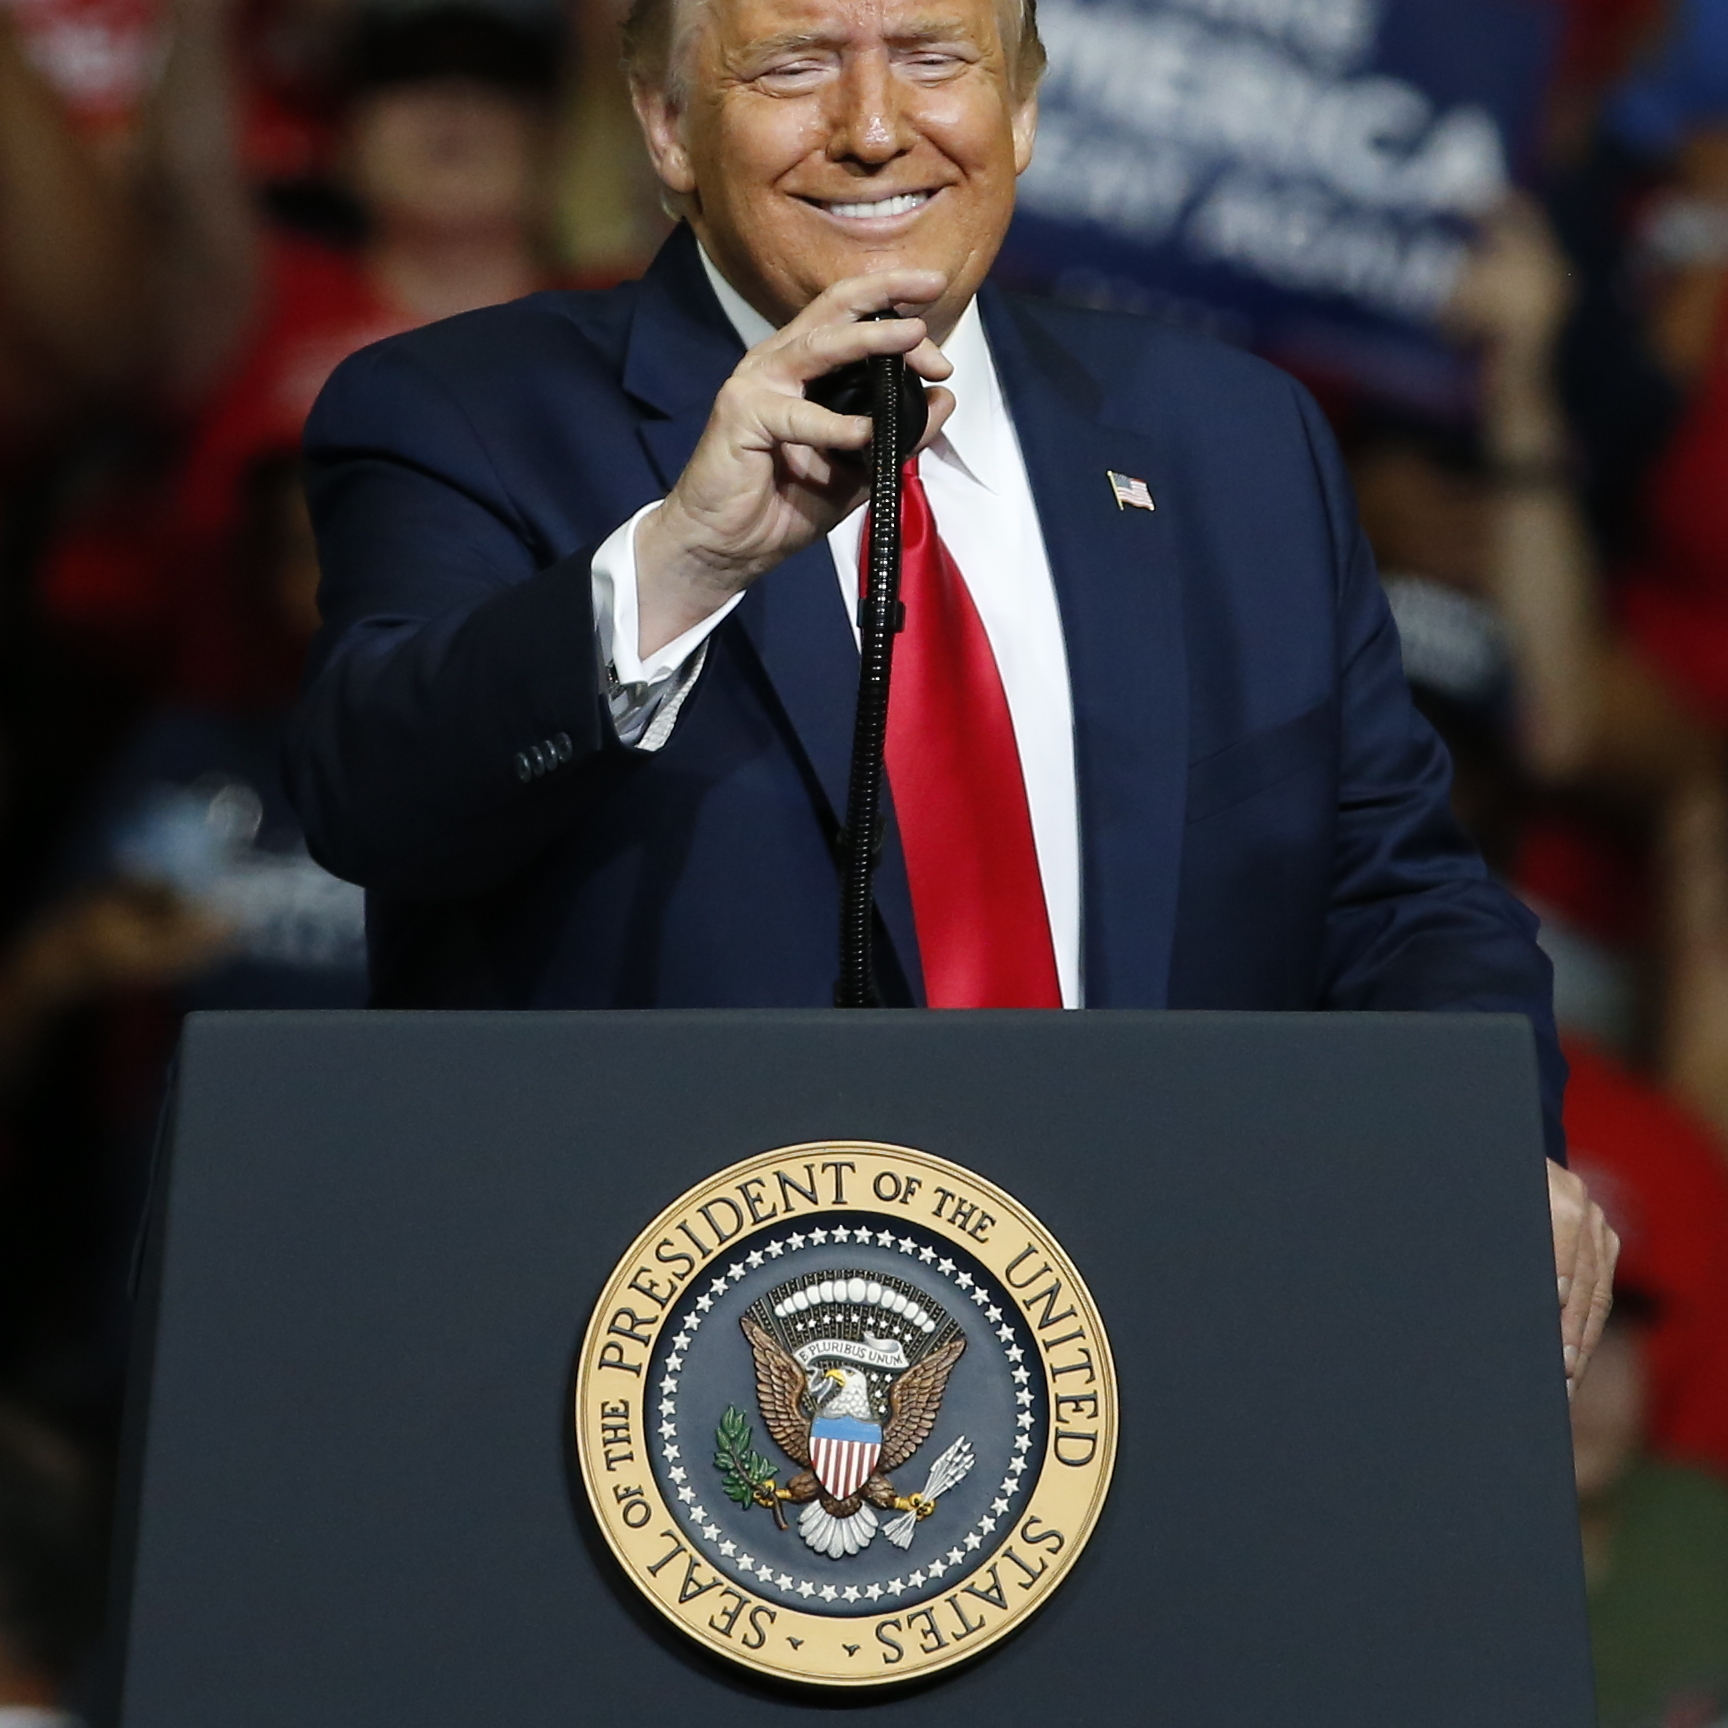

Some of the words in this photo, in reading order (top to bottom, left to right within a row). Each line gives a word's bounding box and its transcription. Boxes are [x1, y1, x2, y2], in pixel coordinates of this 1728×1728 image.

[872, 1170, 922, 1206] OF
[933, 1188, 997, 1245] THE
[598, 1160, 856, 1379] PRESIDENT
[798, 1351, 809, 1364] E
[810, 1341, 868, 1360] PLURIBUS
[868, 1351, 904, 1368] UNUM
[1004, 1241, 1100, 1469] UNITED
[600, 1398, 635, 1473] THE
[614, 1482, 653, 1529] OF
[647, 1529, 777, 1650] SEAL
[874, 1514, 1066, 1665] STATES
